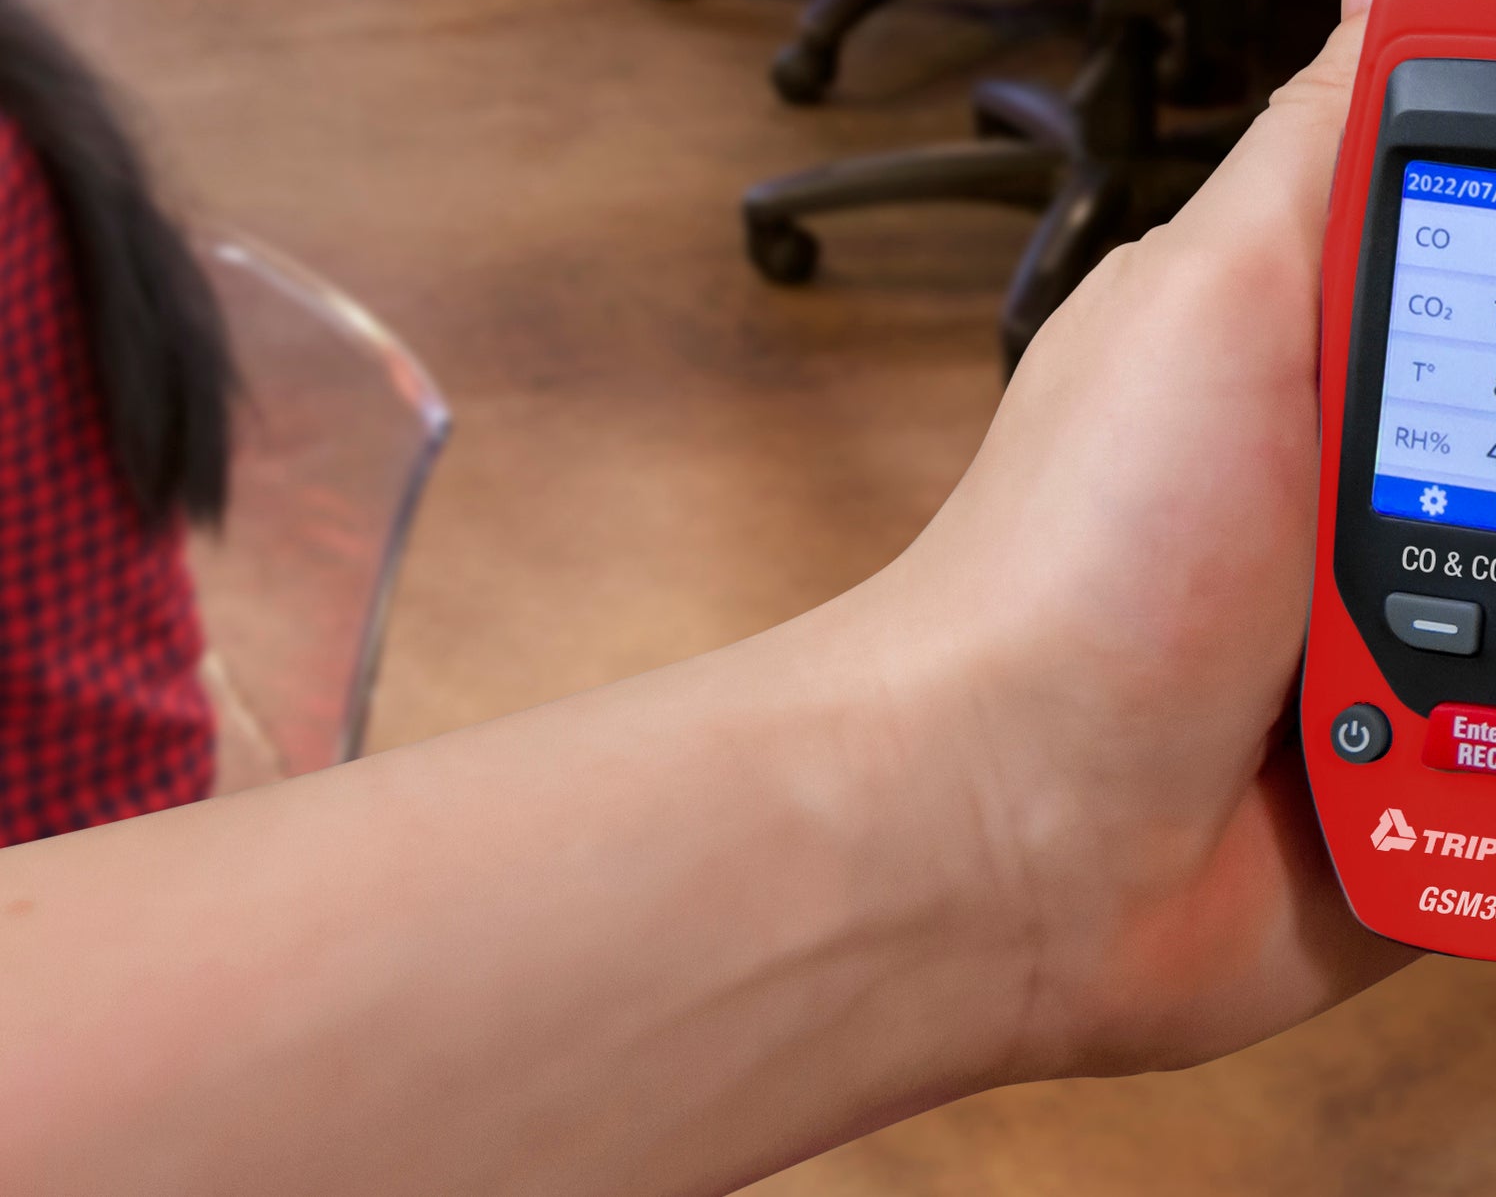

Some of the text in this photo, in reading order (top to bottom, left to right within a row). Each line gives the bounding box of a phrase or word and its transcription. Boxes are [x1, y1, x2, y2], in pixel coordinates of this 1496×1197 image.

[1415, 226, 1451, 251] CO
[1395, 427, 1451, 455] RH%
[1401, 545, 1436, 574] CO
[1444, 552, 1463, 577] &
